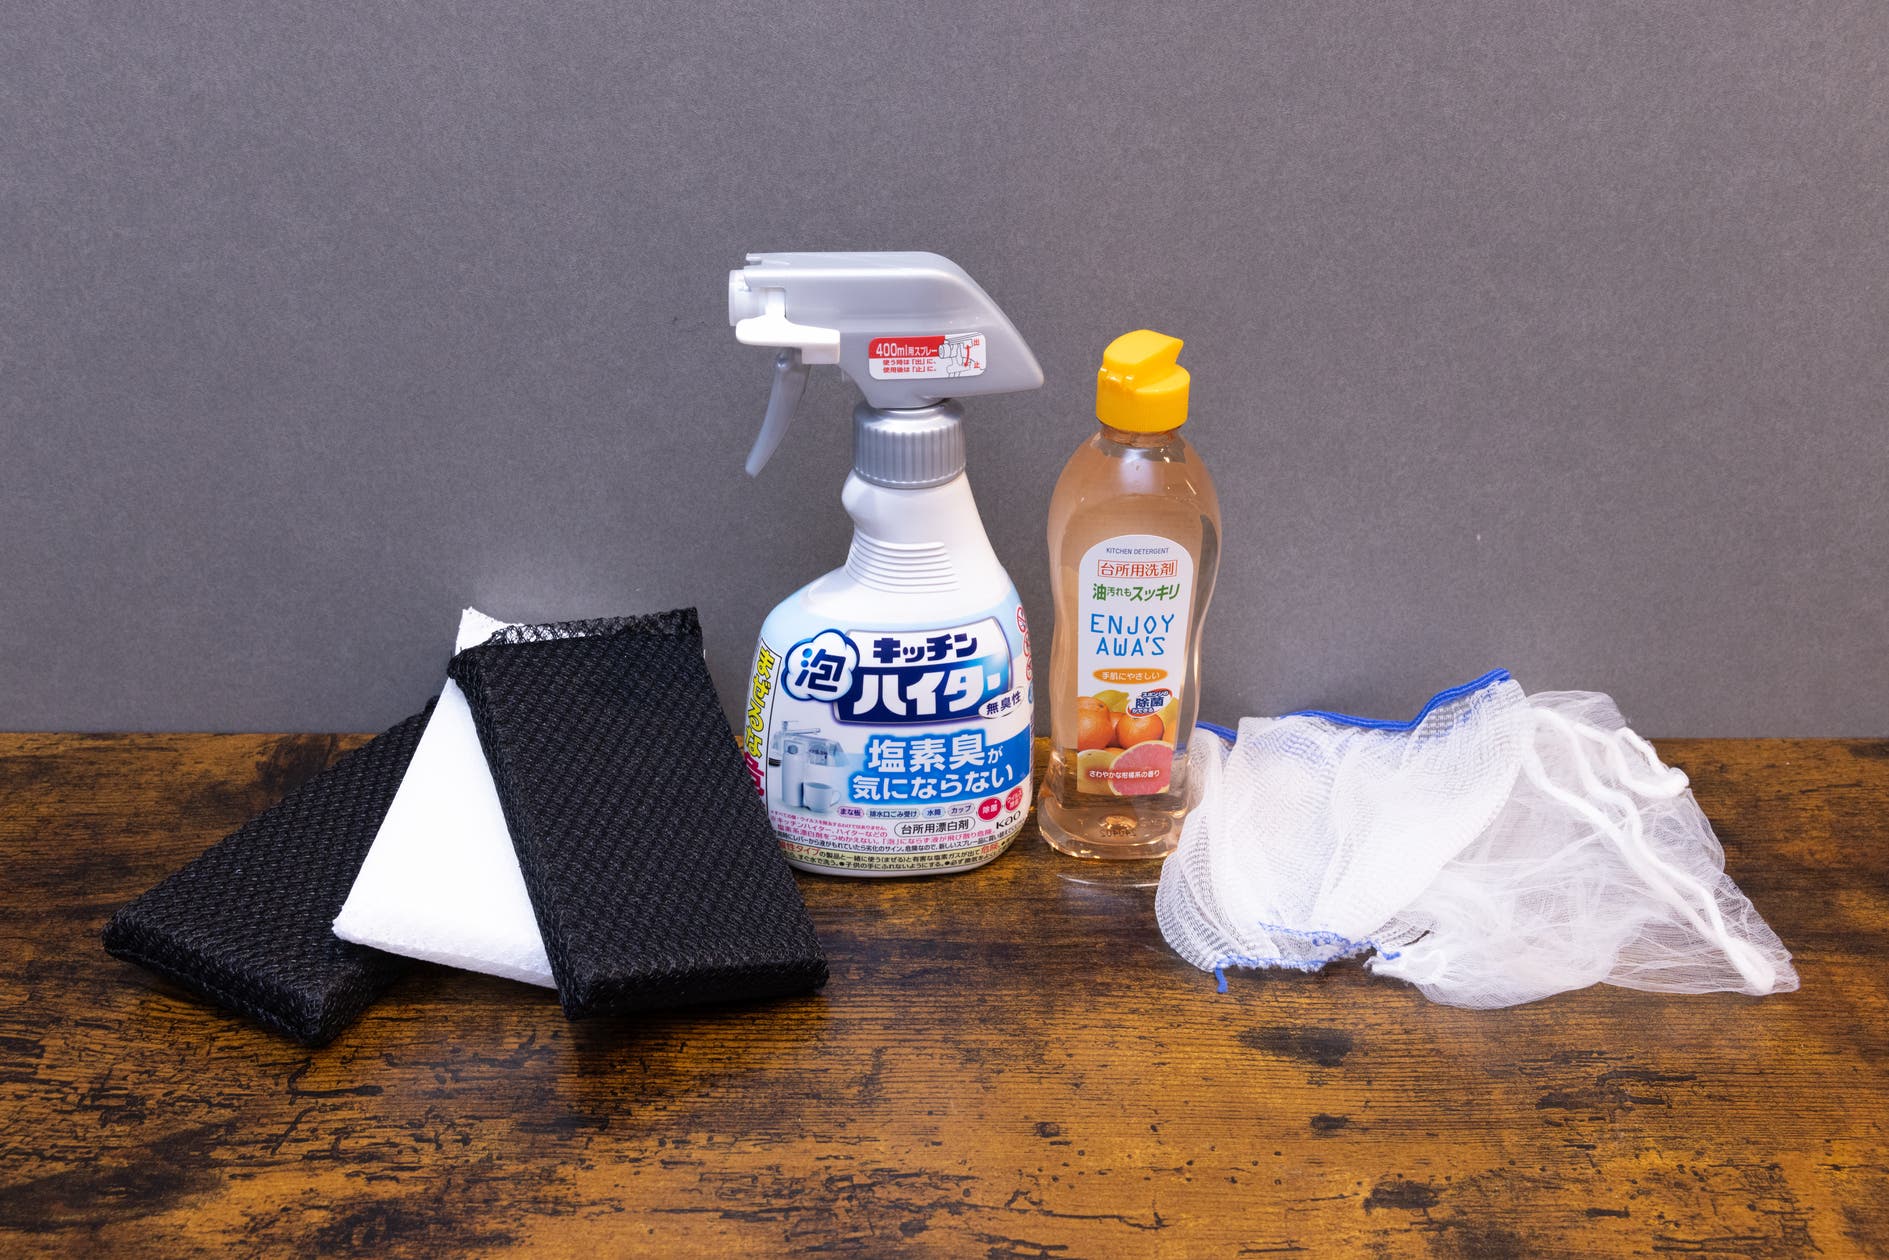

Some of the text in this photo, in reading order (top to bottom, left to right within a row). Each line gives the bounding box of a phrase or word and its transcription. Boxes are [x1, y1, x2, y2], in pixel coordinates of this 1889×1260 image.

[1106, 547, 1169, 555] KITCHEN DETERGENT
[1100, 562, 1174, 577] 台所用洗剤
[1092, 583, 1180, 601] 油汚れもスッキリ
[1090, 613, 1175, 635] ENJOY
[873, 633, 977, 664] キッチン
[1096, 636, 1166, 656] AWA'S
[796, 648, 846, 693] 泡
[1101, 671, 1160, 681] 手肌にやさしい
[853, 665, 1001, 716] ハイター
[986, 690, 1021, 715] 無臭性
[1136, 696, 1163, 708] 除菌
[869, 733, 1003, 773] 塩素臭が
[853, 764, 1013, 801] 気にならない
[840, 808, 861, 816] まな板
[951, 805, 971, 814] カップ
[901, 819, 969, 835] 台所用漂白剤
